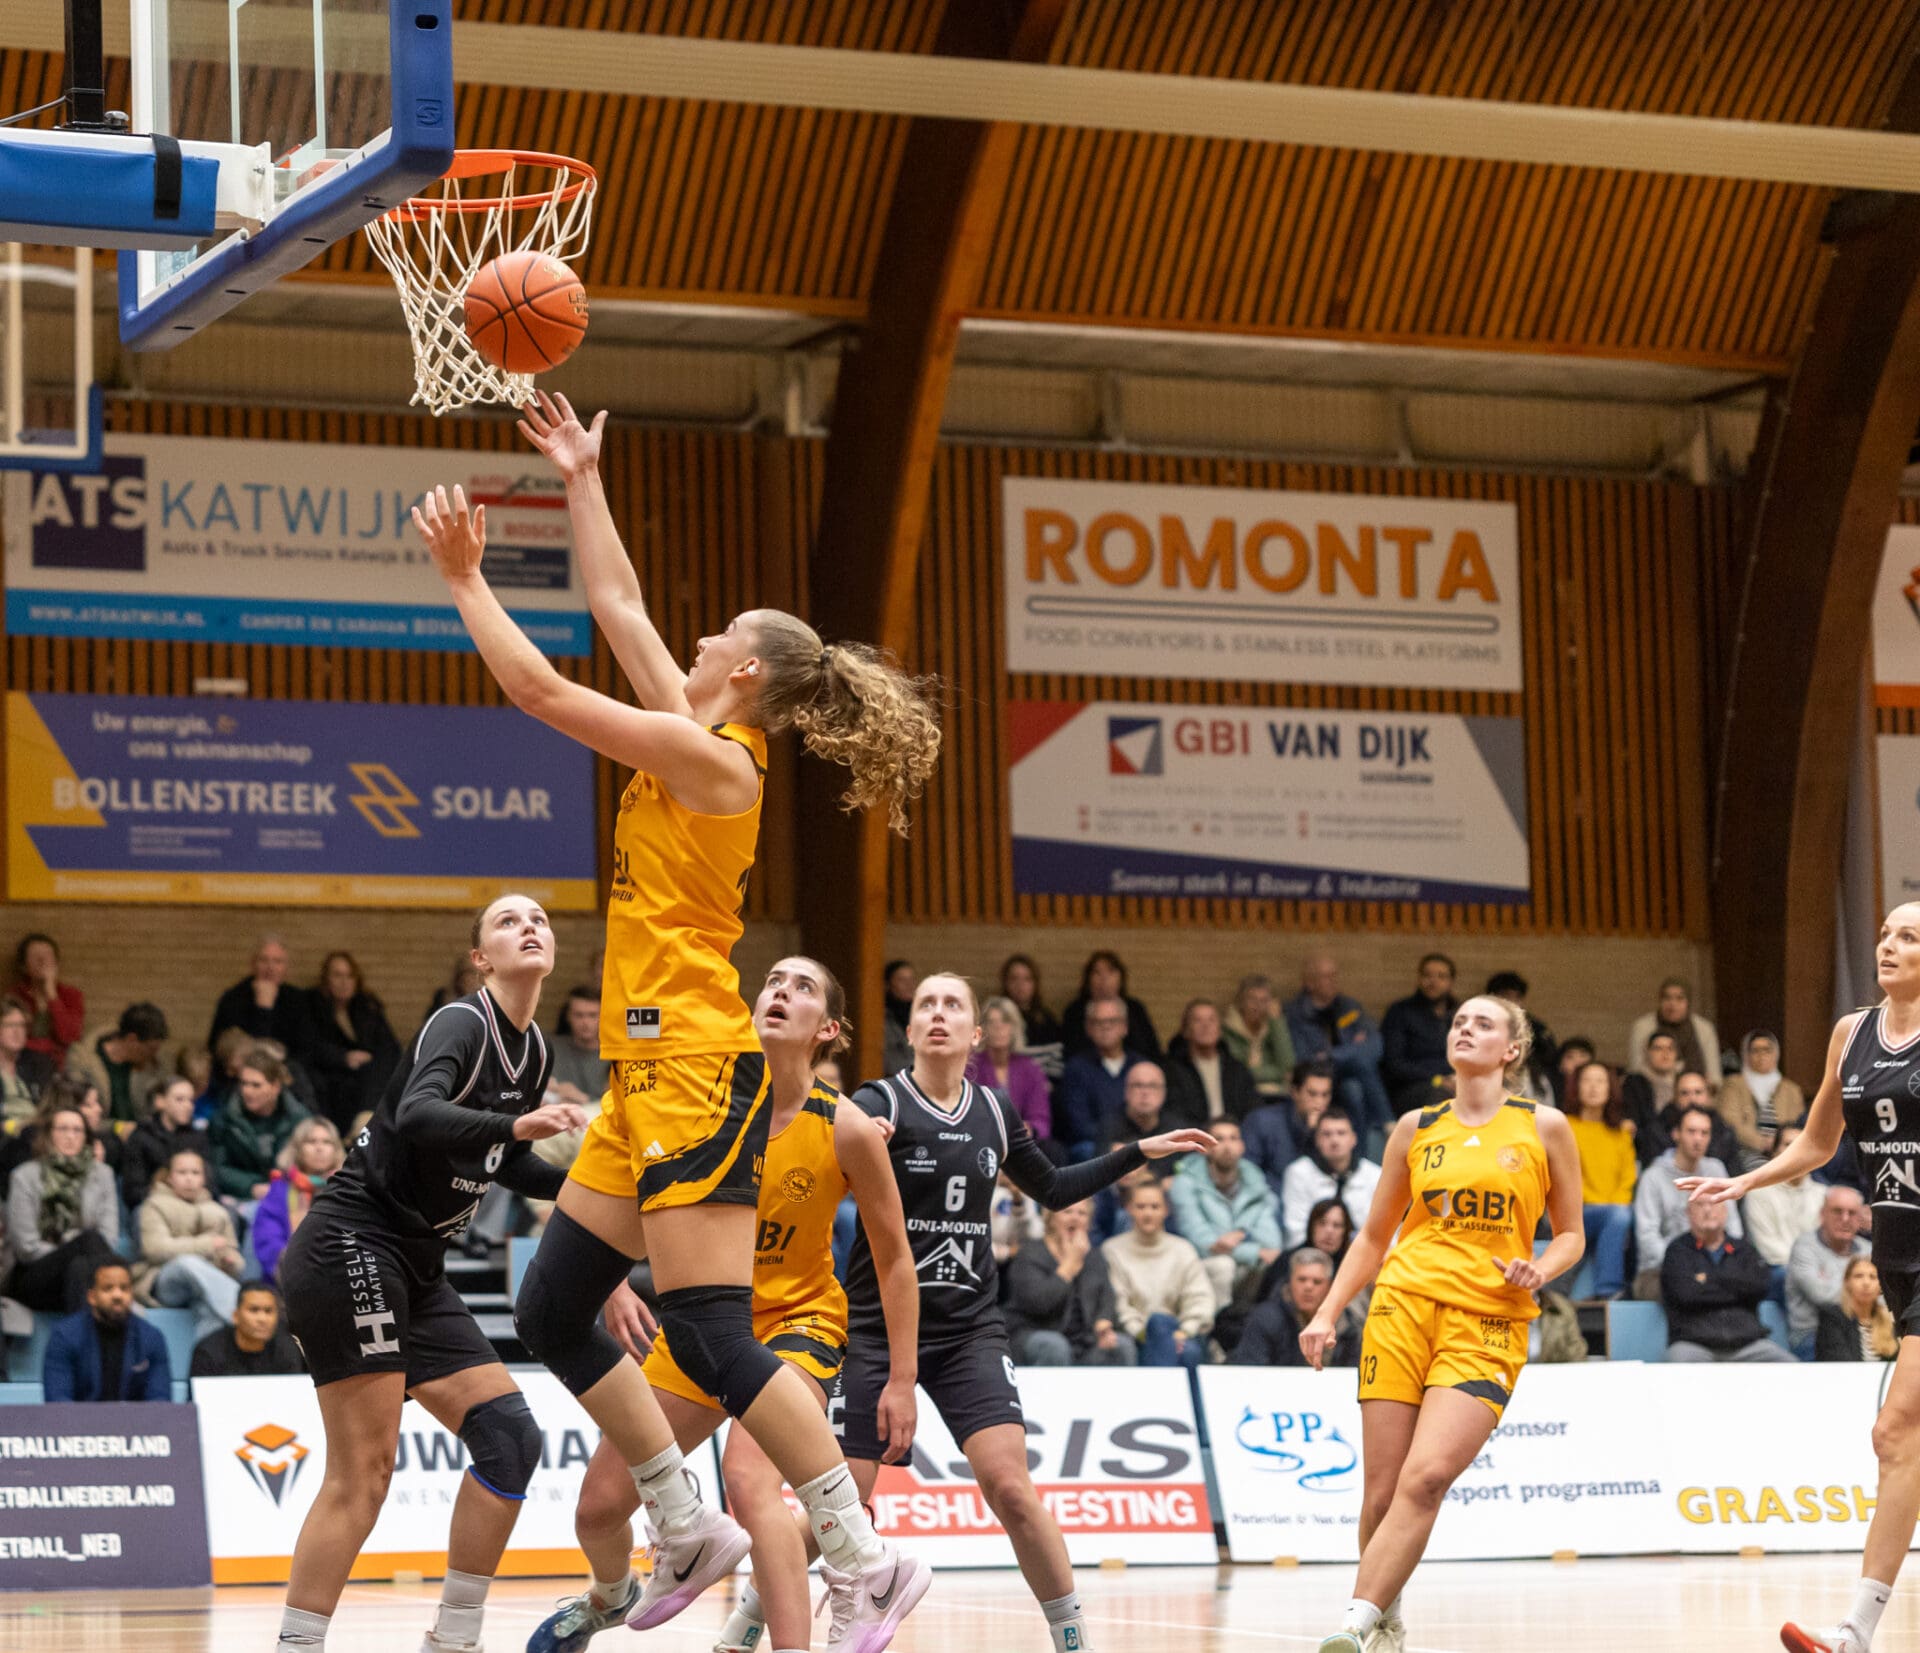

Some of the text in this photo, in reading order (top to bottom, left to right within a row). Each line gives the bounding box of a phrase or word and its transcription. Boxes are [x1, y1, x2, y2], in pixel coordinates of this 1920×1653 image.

[32, 474, 428, 540] ATS KATWIJK
[1024, 508, 1499, 603] ROMONTA
[1174, 718, 1433, 767] GBI VAN DIJK
[53, 777, 552, 821] BOLLENSTREEK SOLAR
[1875, 1098, 1898, 1133] 9
[1423, 1144, 1445, 1172] 13
[945, 1175, 967, 1212] 6
[1452, 1188, 1517, 1223] GBI
[755, 1218, 797, 1252] BI
[907, 1219, 987, 1236] UNI-MOUNT
[363, 1250, 386, 1312] MAATWE
[1362, 1355, 1378, 1386] 13
[1271, 1412, 1322, 1442] PP
[1489, 1421, 1569, 1442] ponsor
[0, 1435, 171, 1459] TBALLNEDERLAND
[1470, 1453, 1495, 1470] et
[0, 1484, 175, 1508] ETBALLNEDERLAND
[1444, 1479, 1662, 1506] sport programma
[1677, 1485, 1878, 1525] GRASSH
[0, 1532, 122, 1561] ETBALL_NED
